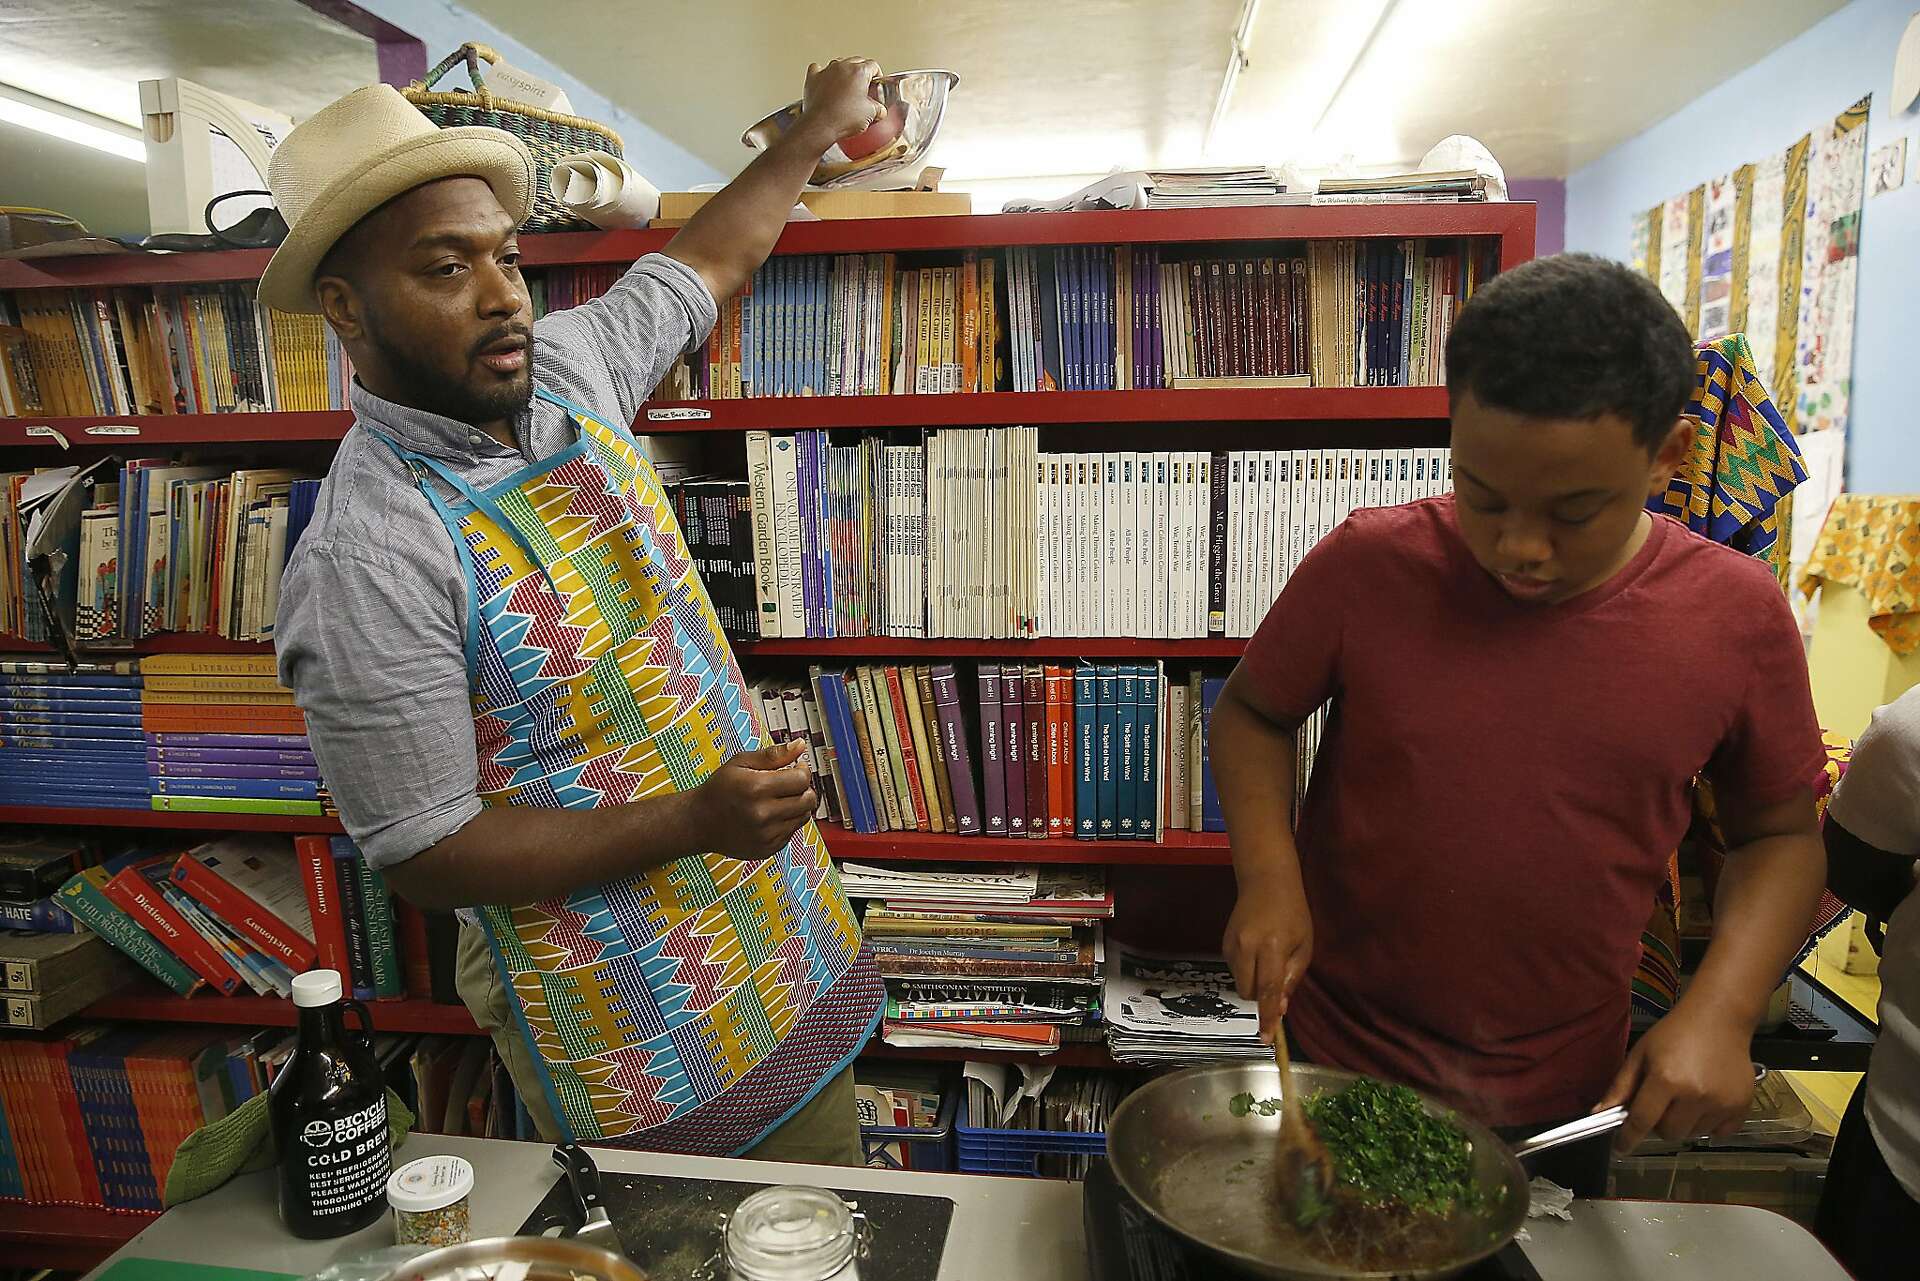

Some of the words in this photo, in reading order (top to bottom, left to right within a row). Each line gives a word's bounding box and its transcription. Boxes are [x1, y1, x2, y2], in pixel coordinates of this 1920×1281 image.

[753, 462, 766, 510] Western
[785, 471, 797, 494] ONE
[1212, 464, 1220, 500] HAMILTON
[787, 496, 800, 545] VOLUME
[1092, 514, 1100, 535] Making
[1216, 510, 1224, 521] M.
[756, 512, 771, 555] Garden
[775, 502, 790, 589] ENCYCLOPEDIA
[1123, 547, 1132, 564] People
[1140, 548, 1149, 566] People
[1231, 552, 1239, 562] and
[1246, 552, 1254, 562] and
[760, 558, 774, 589] Book
[1214, 568, 1223, 581] the
[789, 548, 803, 619] ILLUSTRATED
[1213, 583, 1222, 603] Great
[191, 663, 243, 672] LITERACY
[247, 663, 276, 673] PLAC
[947, 722, 956, 744] Burning
[1124, 723, 1132, 733] The
[1124, 734, 1132, 748] Spirit
[950, 744, 959, 761] Bright
[989, 744, 997, 760] Bright
[1010, 744, 1018, 761] Bright
[1124, 756, 1132, 765] the
[1124, 766, 1132, 780] Wind
[311, 858, 328, 915] Dictionary
[5, 906, 32, 921] HATE
[134, 893, 180, 938] Dictionary
[375, 888, 392, 956] SCHOLASTIC
[107, 911, 162, 960] SCHOLASTIC
[953, 927, 998, 936] STORIES
[918, 948, 941, 956] Jocelyn
[943, 950, 966, 958] Murray
[124, 940, 179, 989] DICTIONARY
[1147, 969, 1235, 984] MAGIC
[973, 985, 1028, 993] INSTITUTION
[334, 1097, 385, 1132] BICYCLE
[307, 1149, 352, 1167] COLD
[356, 1125, 388, 1156] BREW
[309, 1171, 334, 1180] KEEP
[310, 1179, 332, 1188] BEST
[333, 1170, 366, 1186] SERVED
[366, 1159, 382, 1173] OVER
[311, 1186, 345, 1197] PLEASE
[347, 1176, 371, 1190] WASH
[312, 1187, 368, 1206] THOROUGHLY
[312, 1200, 362, 1216] RETURNING
[363, 1194, 373, 1203] TO
